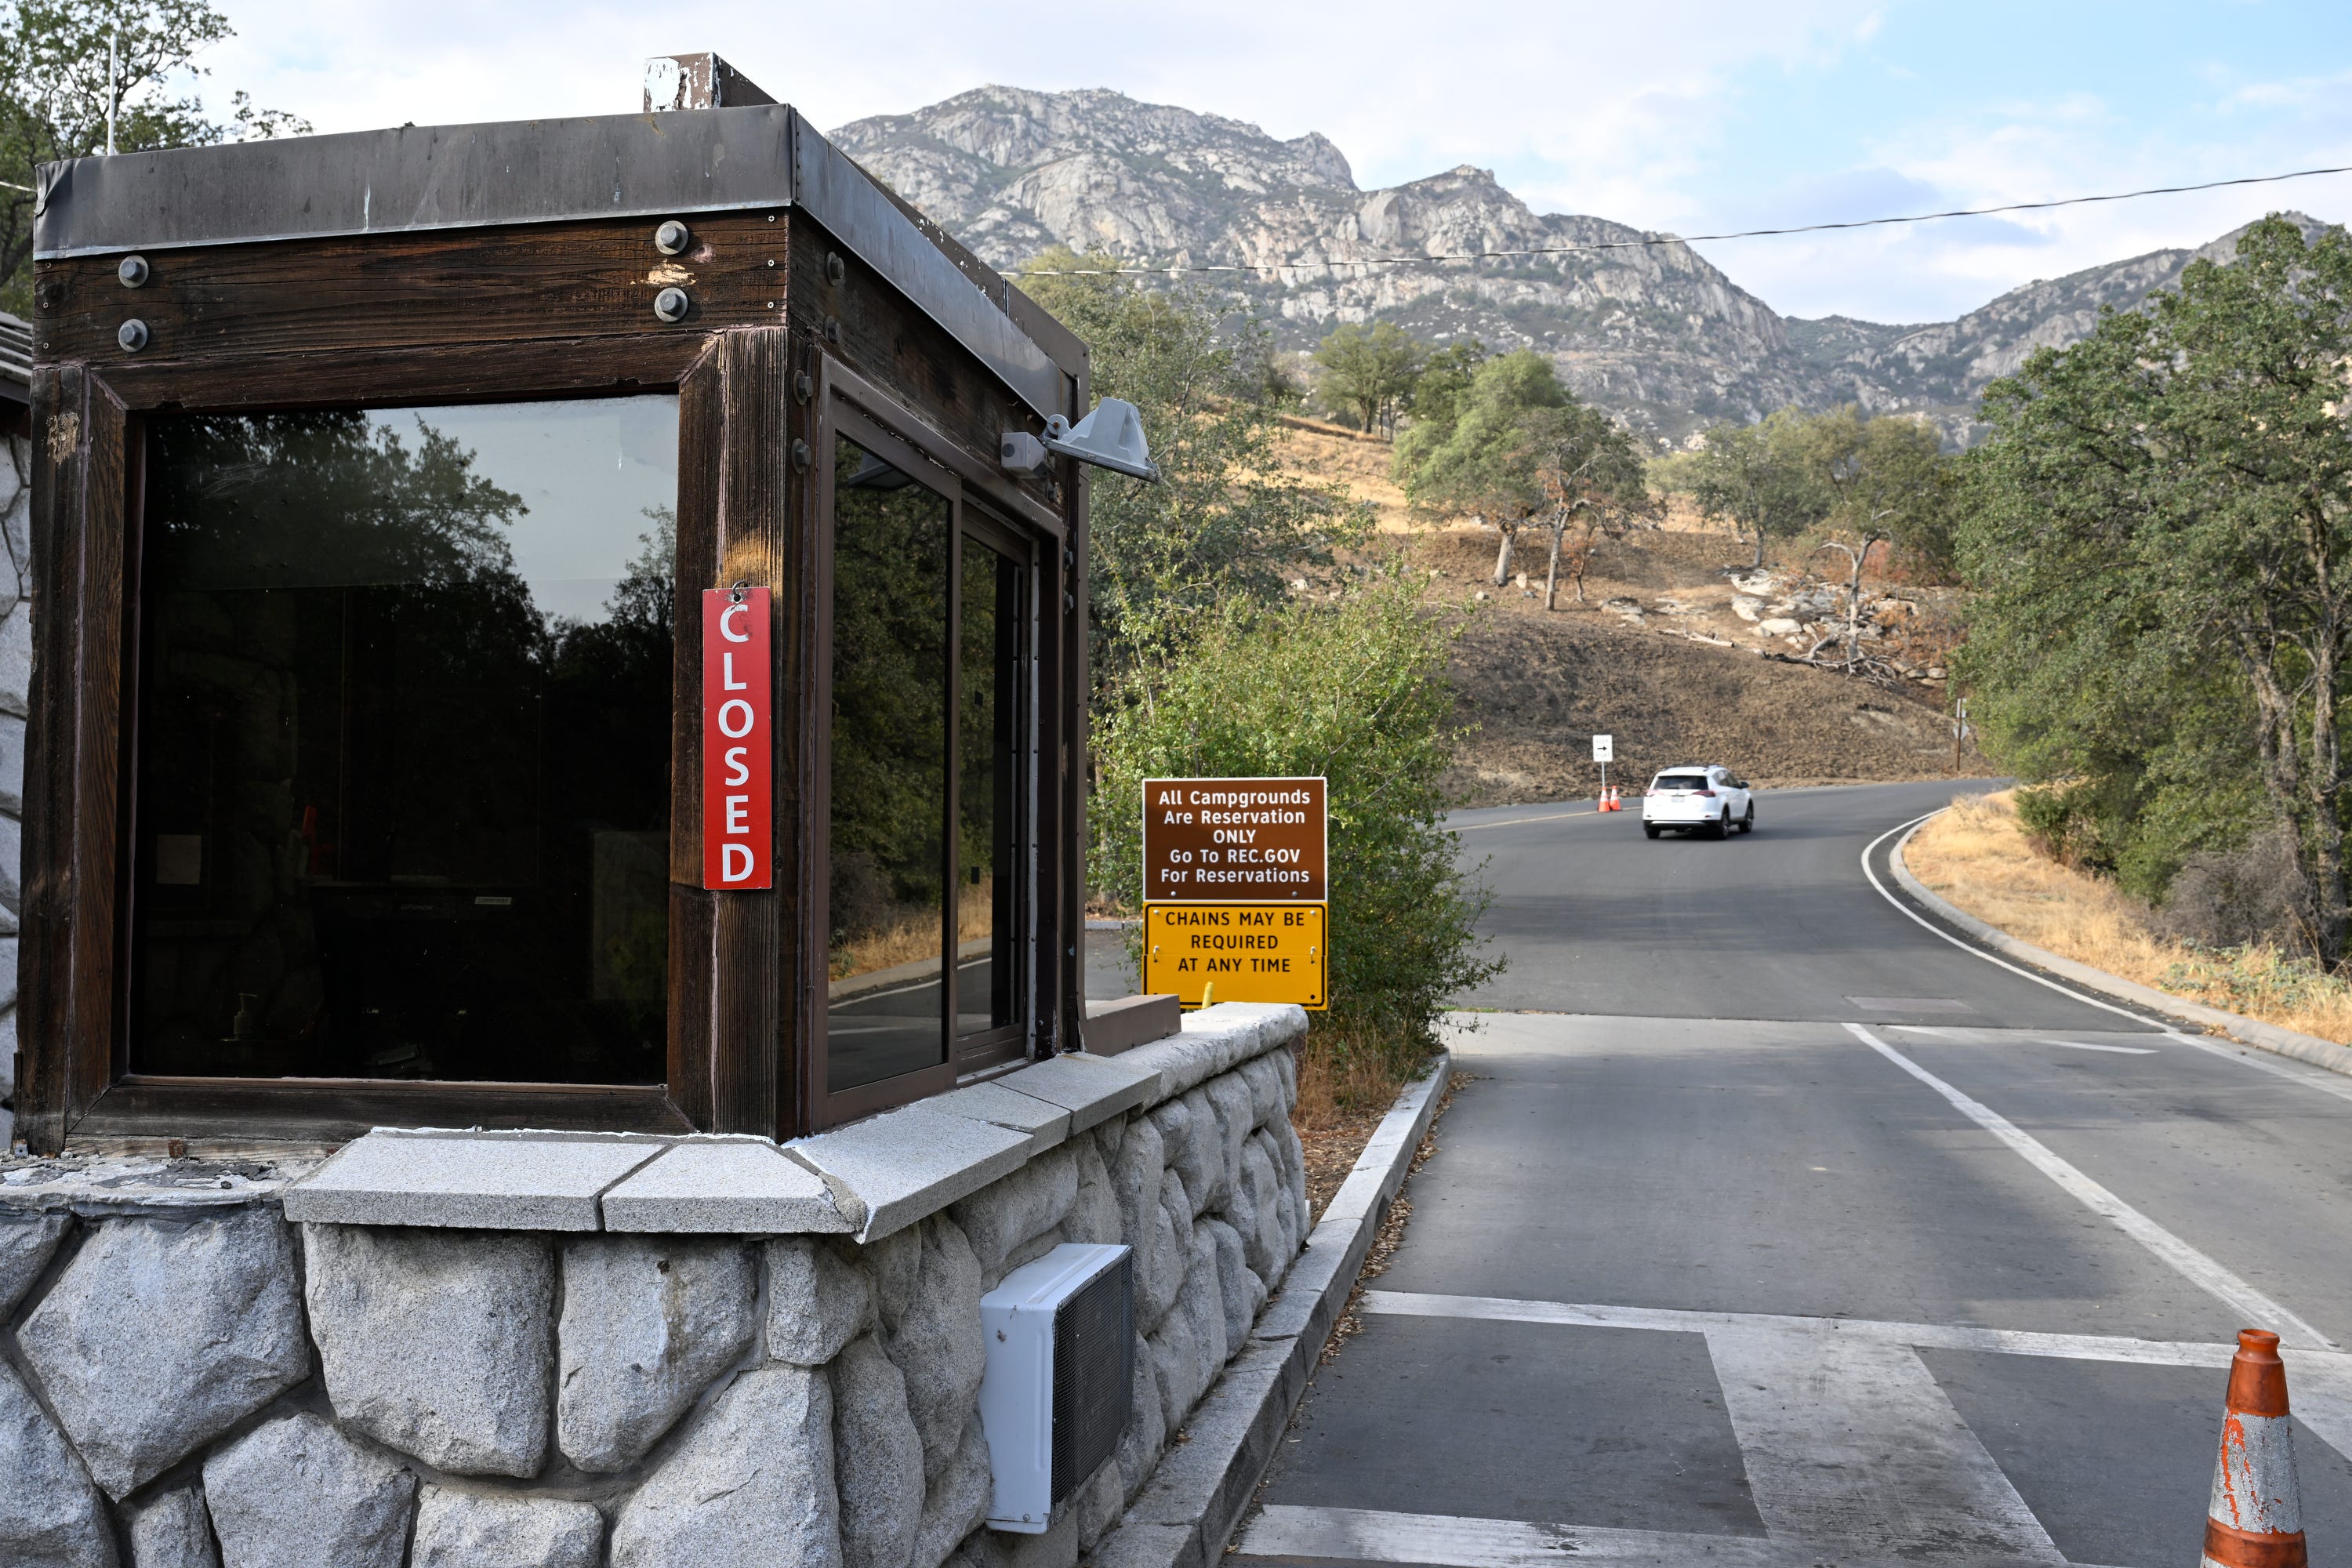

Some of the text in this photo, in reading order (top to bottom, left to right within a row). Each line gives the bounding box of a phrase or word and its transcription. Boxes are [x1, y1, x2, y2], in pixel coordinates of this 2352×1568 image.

[717, 604, 754, 883] CLOSED
[1160, 789, 1310, 808] All Campgrounds
[1164, 808, 1305, 824] Are Reservation
[1214, 829, 1256, 843] ONLY
[1171, 849, 1300, 862] Go To REC.GOV
[1162, 868, 1308, 882] For Reservations
[1166, 912, 1304, 926] CHAINS MAY BE
[1192, 935, 1278, 949] REQUIRED
[1178, 958, 1290, 972] AT ANY TIME
